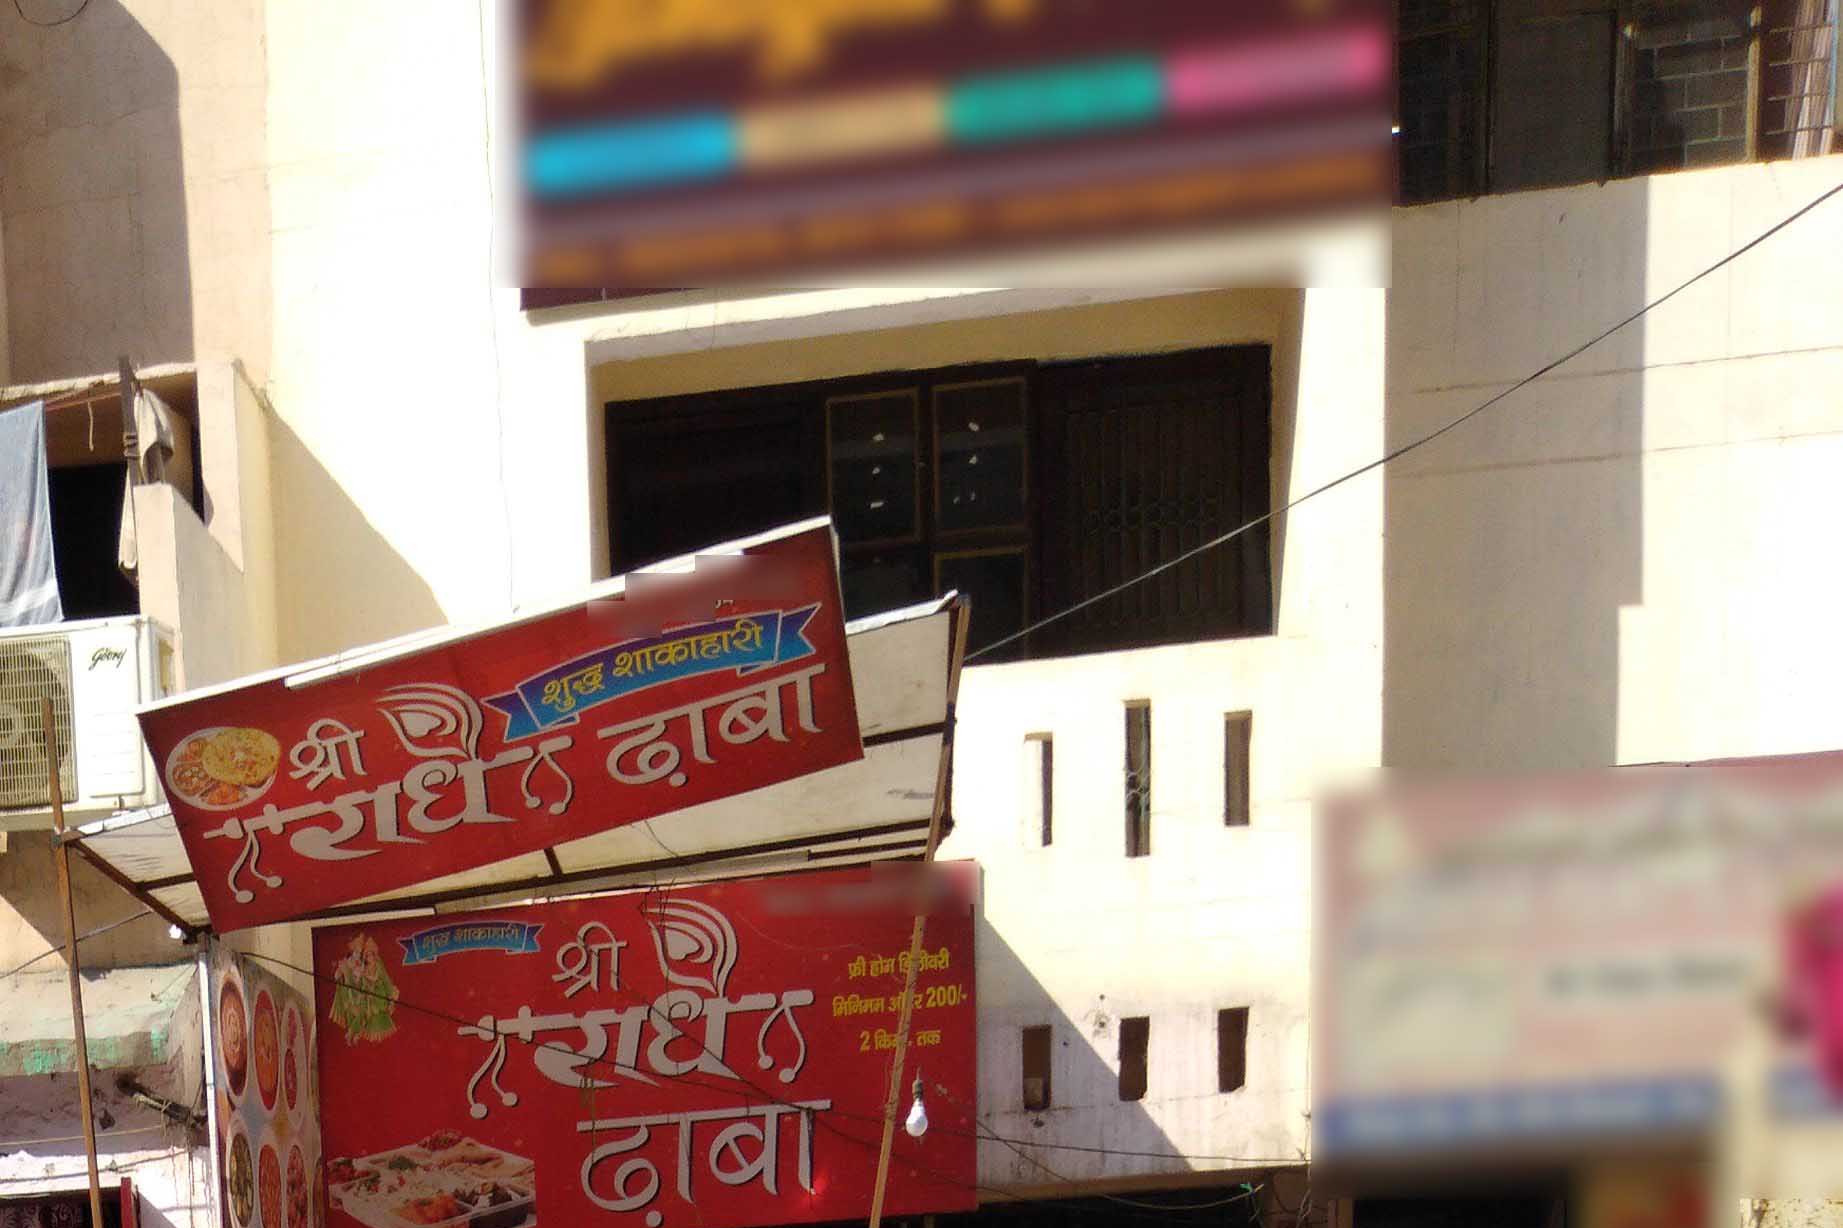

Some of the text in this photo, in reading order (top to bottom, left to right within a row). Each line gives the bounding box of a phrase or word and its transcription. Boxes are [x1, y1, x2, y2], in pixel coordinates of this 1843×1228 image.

[543, 617, 766, 712] शुद्ध शाकाहारी
[288, 717, 366, 788] श्री
[552, 920, 628, 999] श्री
[860, 1030, 871, 1052] 2
